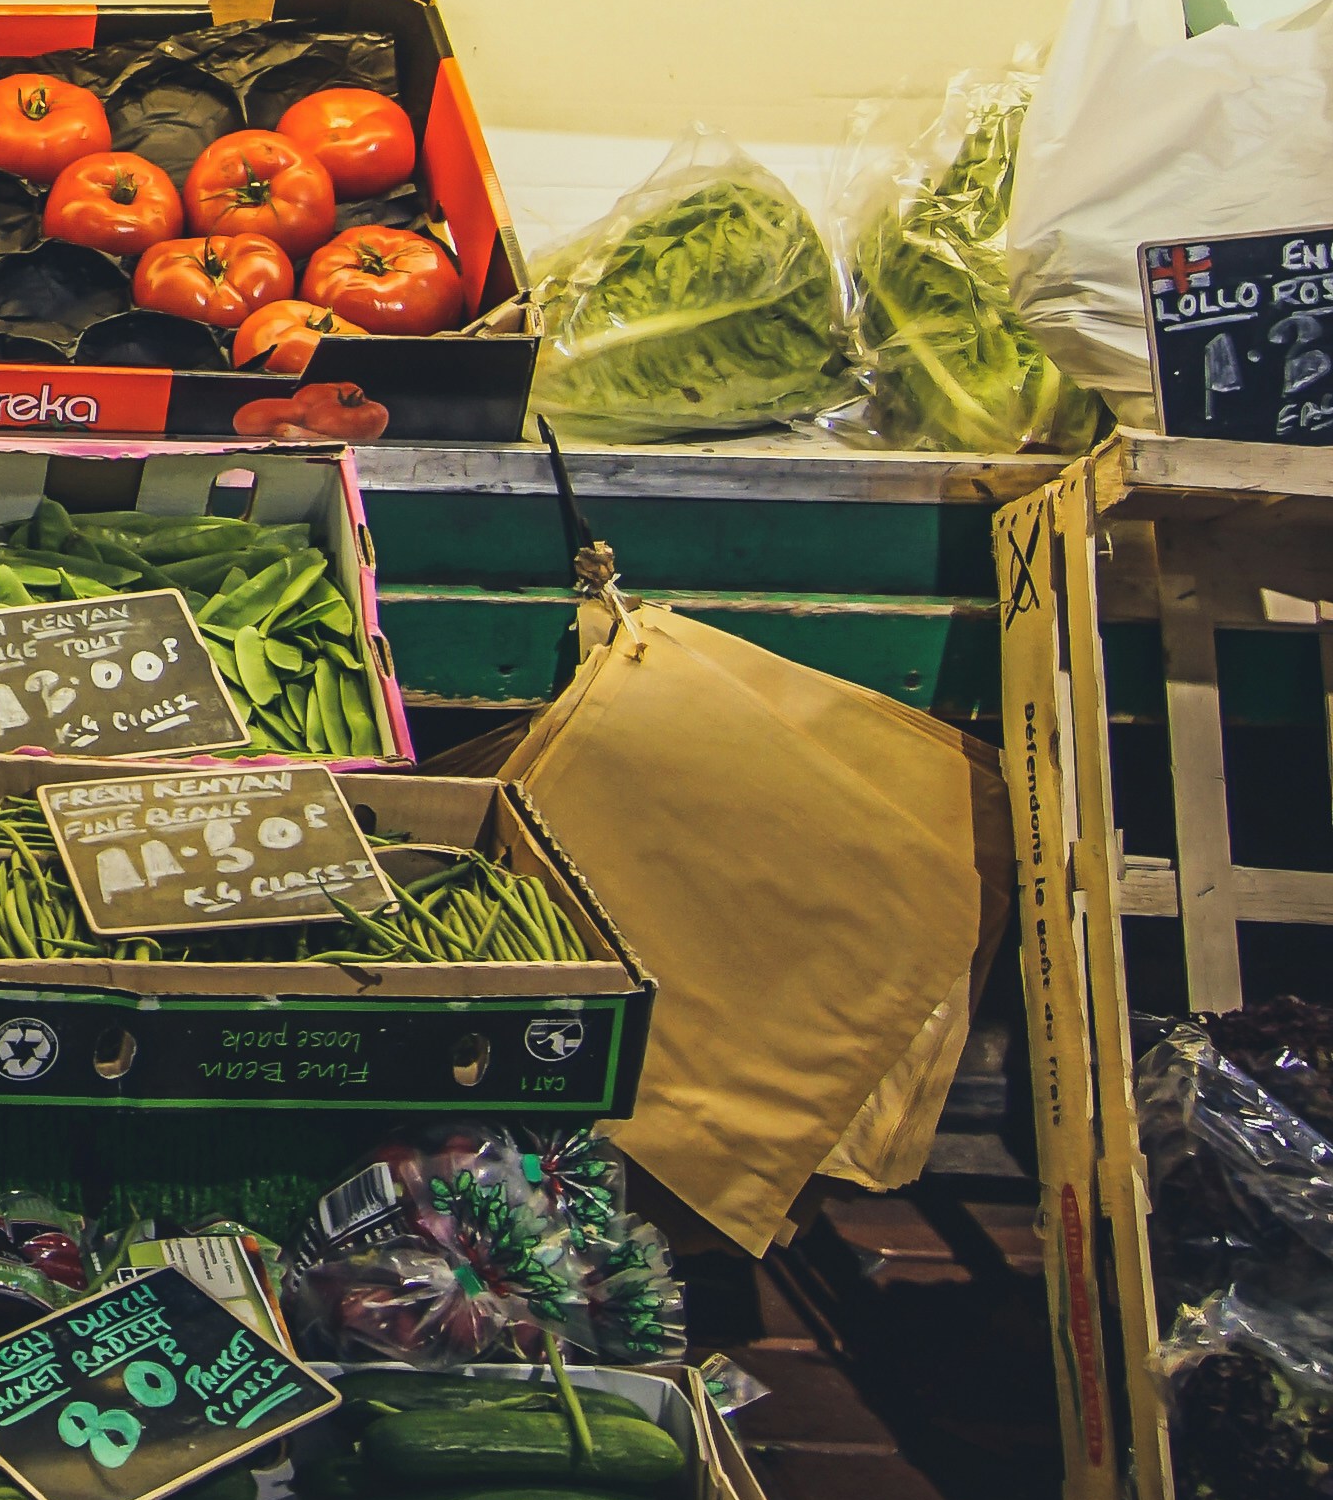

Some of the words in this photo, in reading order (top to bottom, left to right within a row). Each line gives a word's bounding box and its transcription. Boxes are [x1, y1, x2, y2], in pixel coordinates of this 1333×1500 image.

[1156, 282, 1259, 322] LOLLO
[22, 604, 130, 633] KENYAN
[54, 631, 128, 658] TOUT
[50, 784, 143, 811] FRESH
[153, 772, 292, 798] KENYAN
[64, 813, 136, 840] FINE
[145, 801, 252, 826] BEANS
[223, 1022, 287, 1053] pack
[199, 1061, 286, 1084] Bean
[298, 1061, 368, 1086] Fine
[537, 1077, 565, 1091] CAT
[68, 1284, 158, 1337] DUTCH
[72, 1308, 172, 1372] RADISH
[185, 1330, 255, 1400] PACKET
